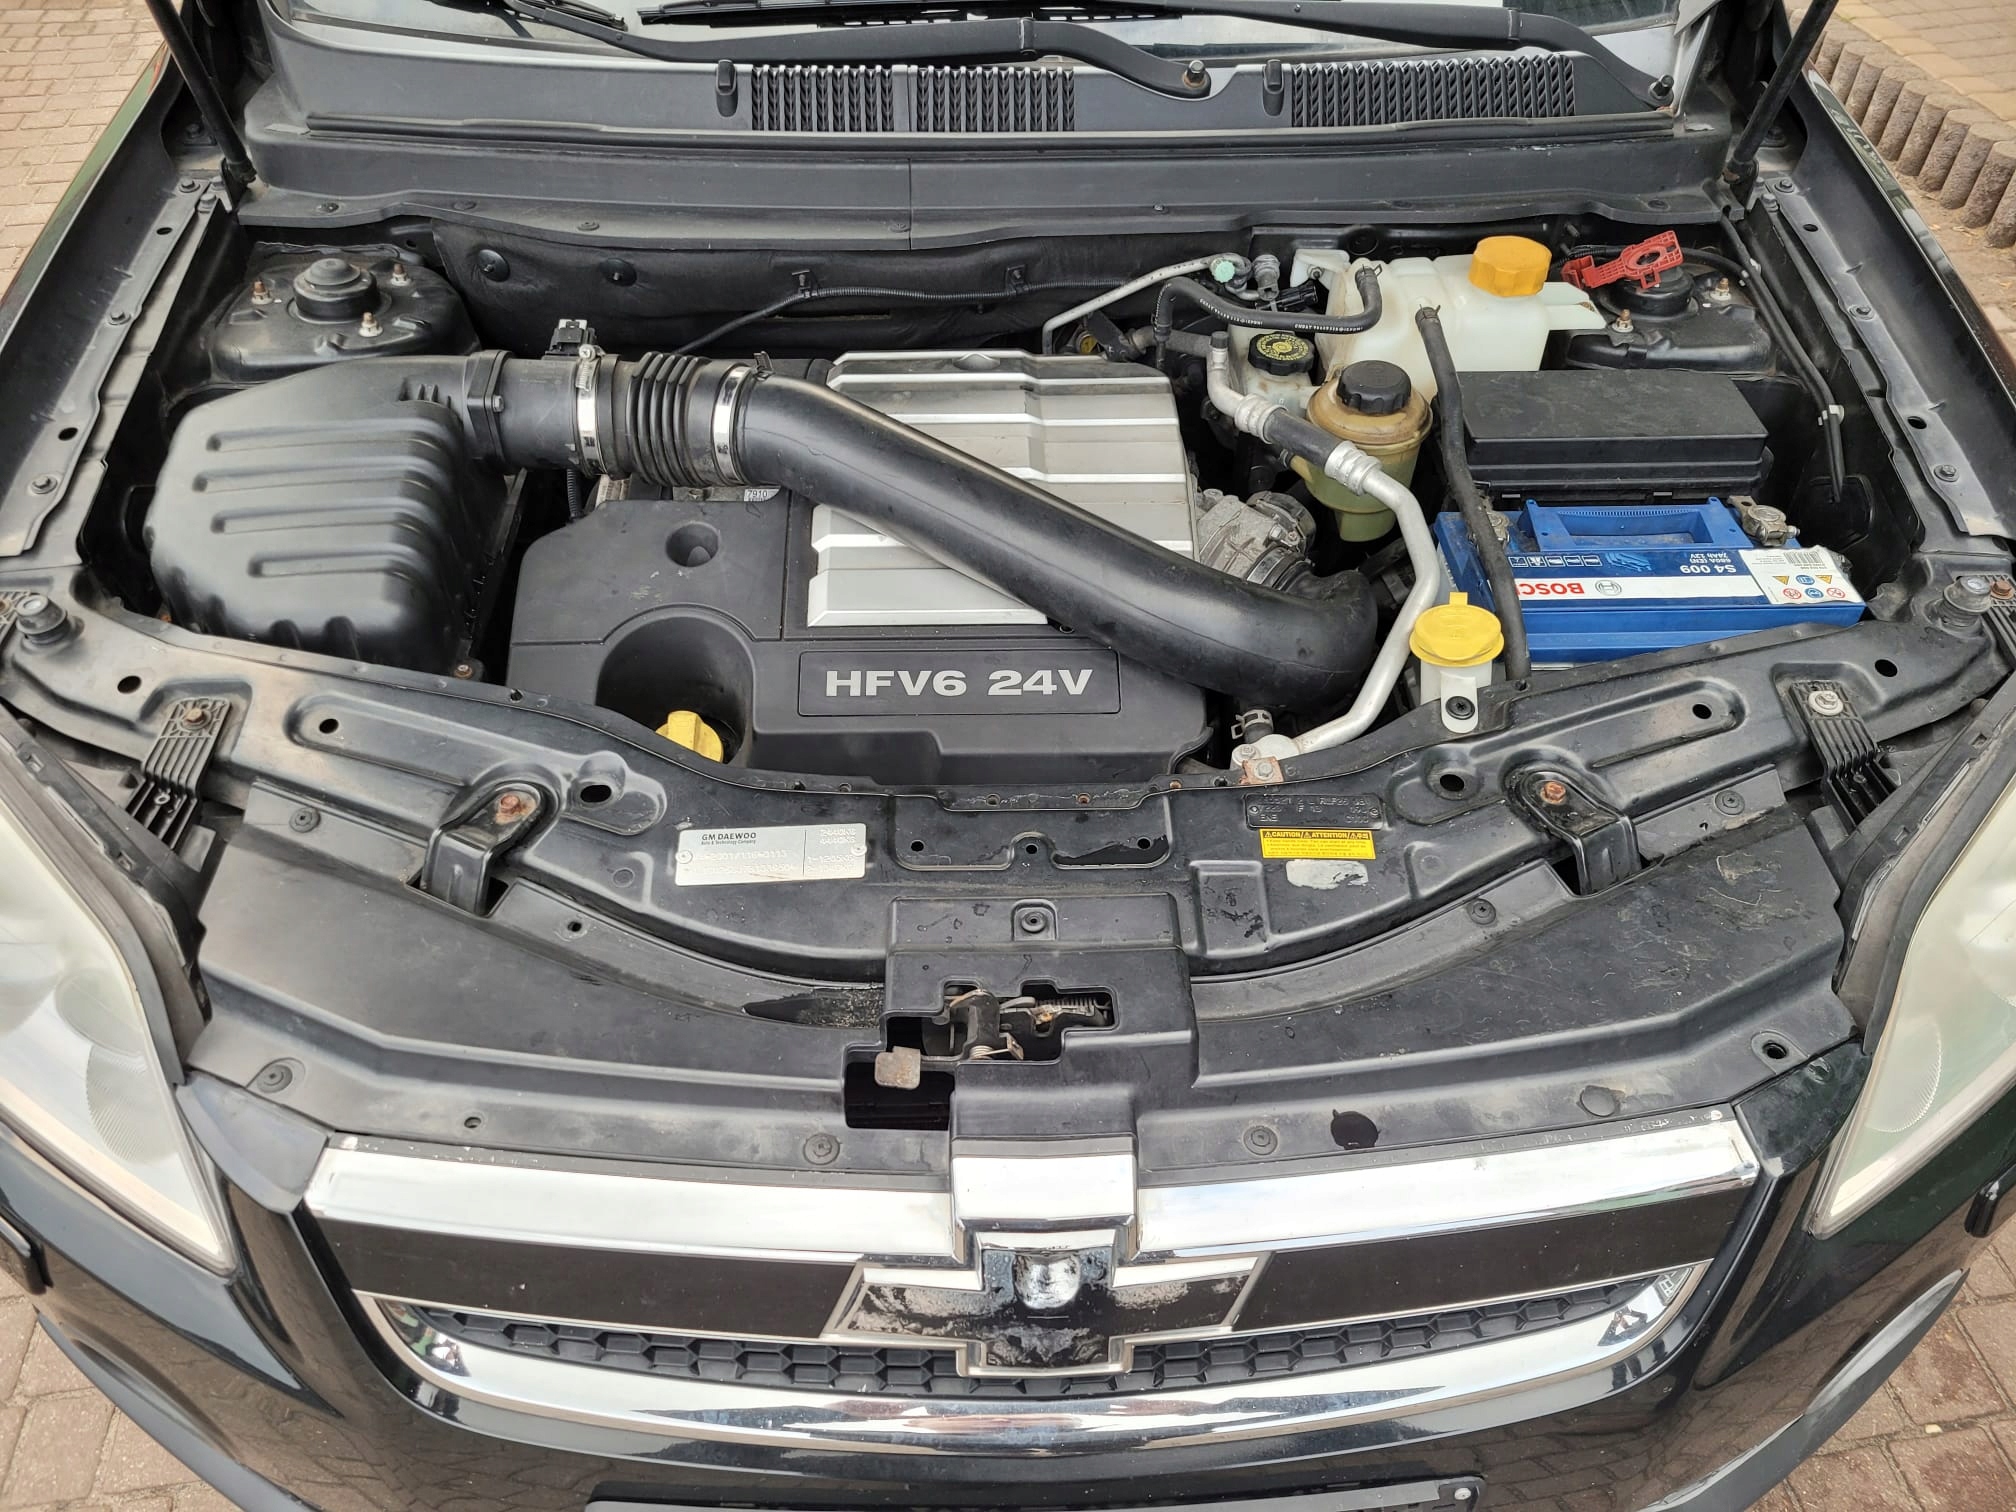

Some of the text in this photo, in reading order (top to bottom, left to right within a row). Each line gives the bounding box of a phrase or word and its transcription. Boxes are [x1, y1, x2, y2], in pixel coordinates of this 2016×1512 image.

[746, 489, 768, 498] 7910
[1679, 564, 1737, 574] S4 009
[1514, 582, 1585, 596] BOSC
[825, 669, 1093, 697] HFV6 24V
[701, 832, 757, 841] GM DAEWOO
